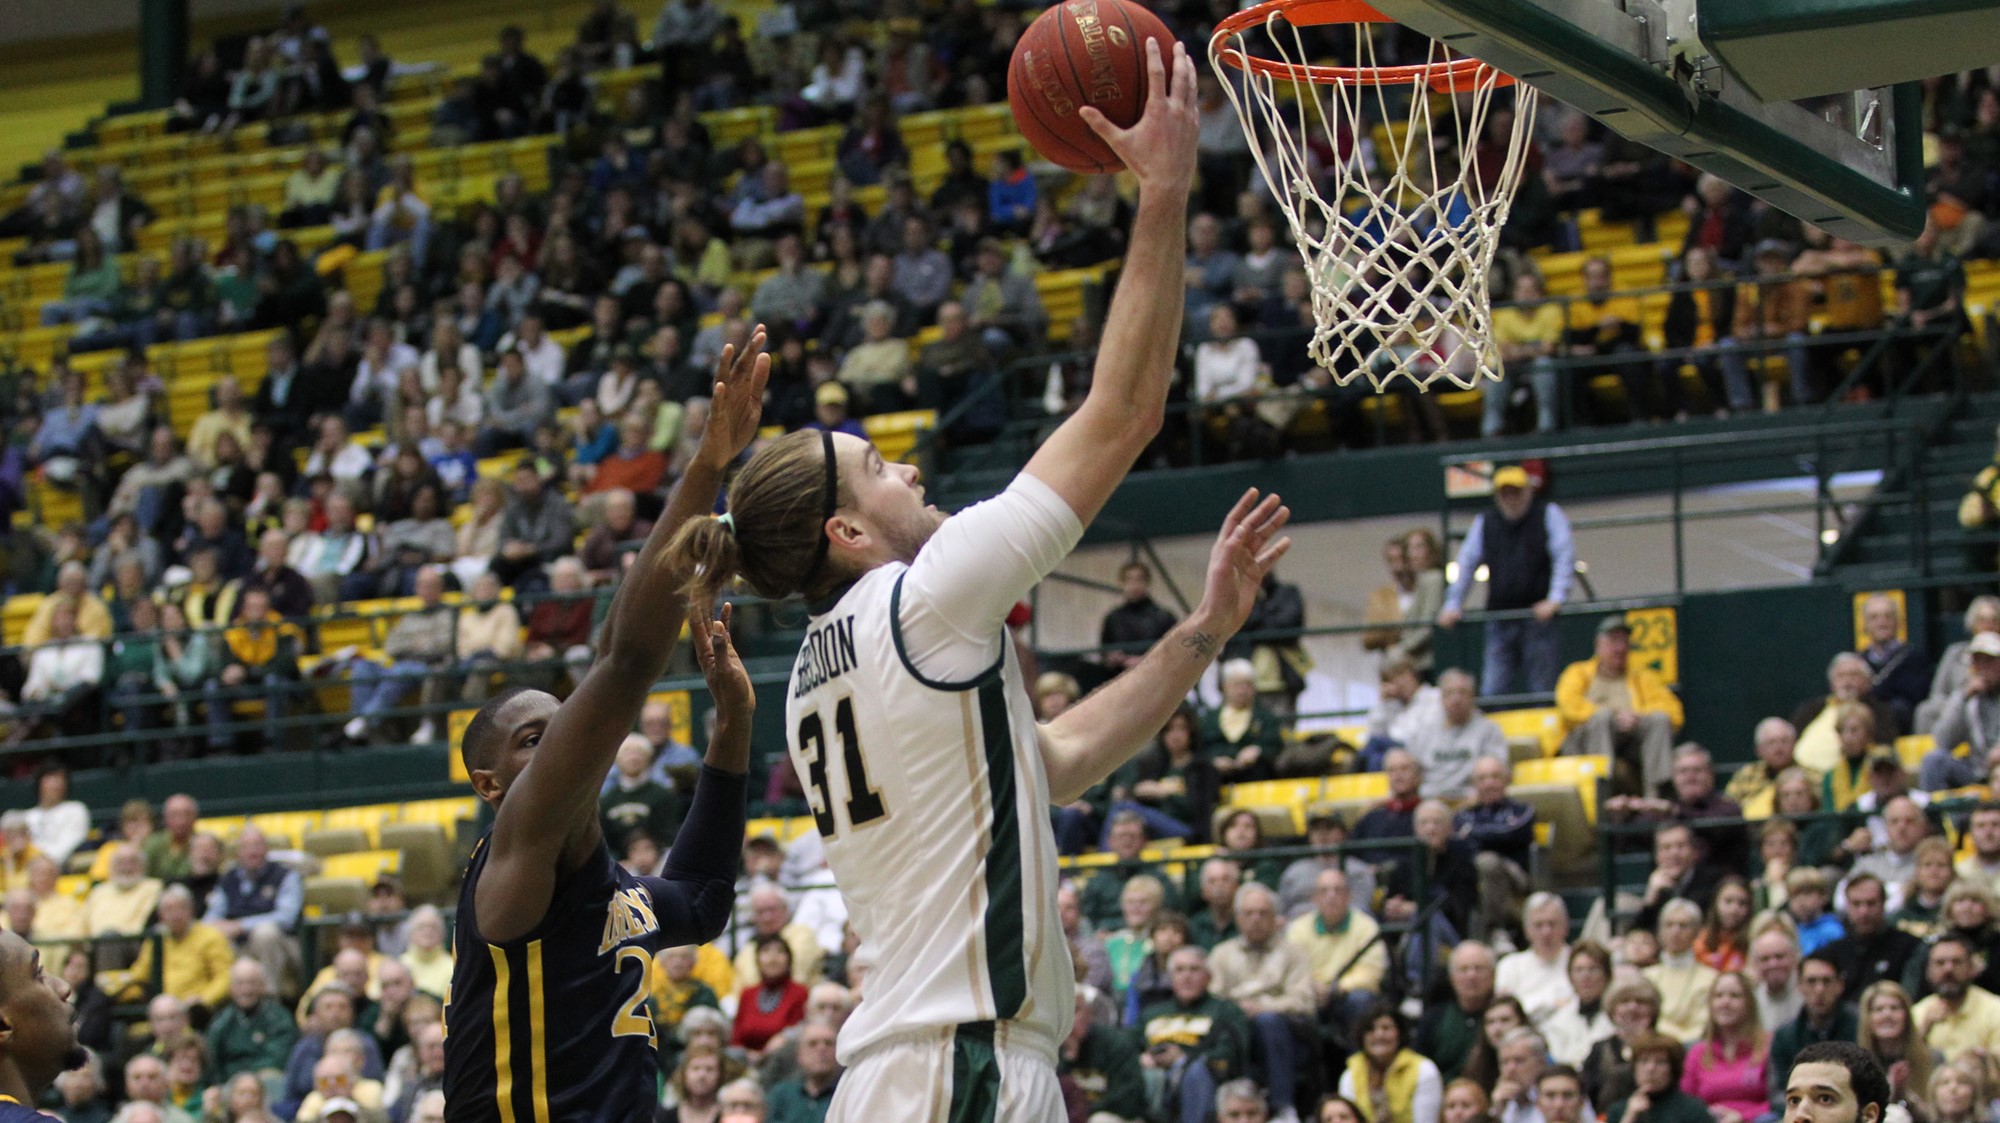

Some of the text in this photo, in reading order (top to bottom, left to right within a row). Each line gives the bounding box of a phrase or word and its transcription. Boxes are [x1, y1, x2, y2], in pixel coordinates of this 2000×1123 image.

[1067, 0, 1121, 102] PALDING
[1629, 616, 1673, 651] 23
[797, 691, 891, 841] 31
